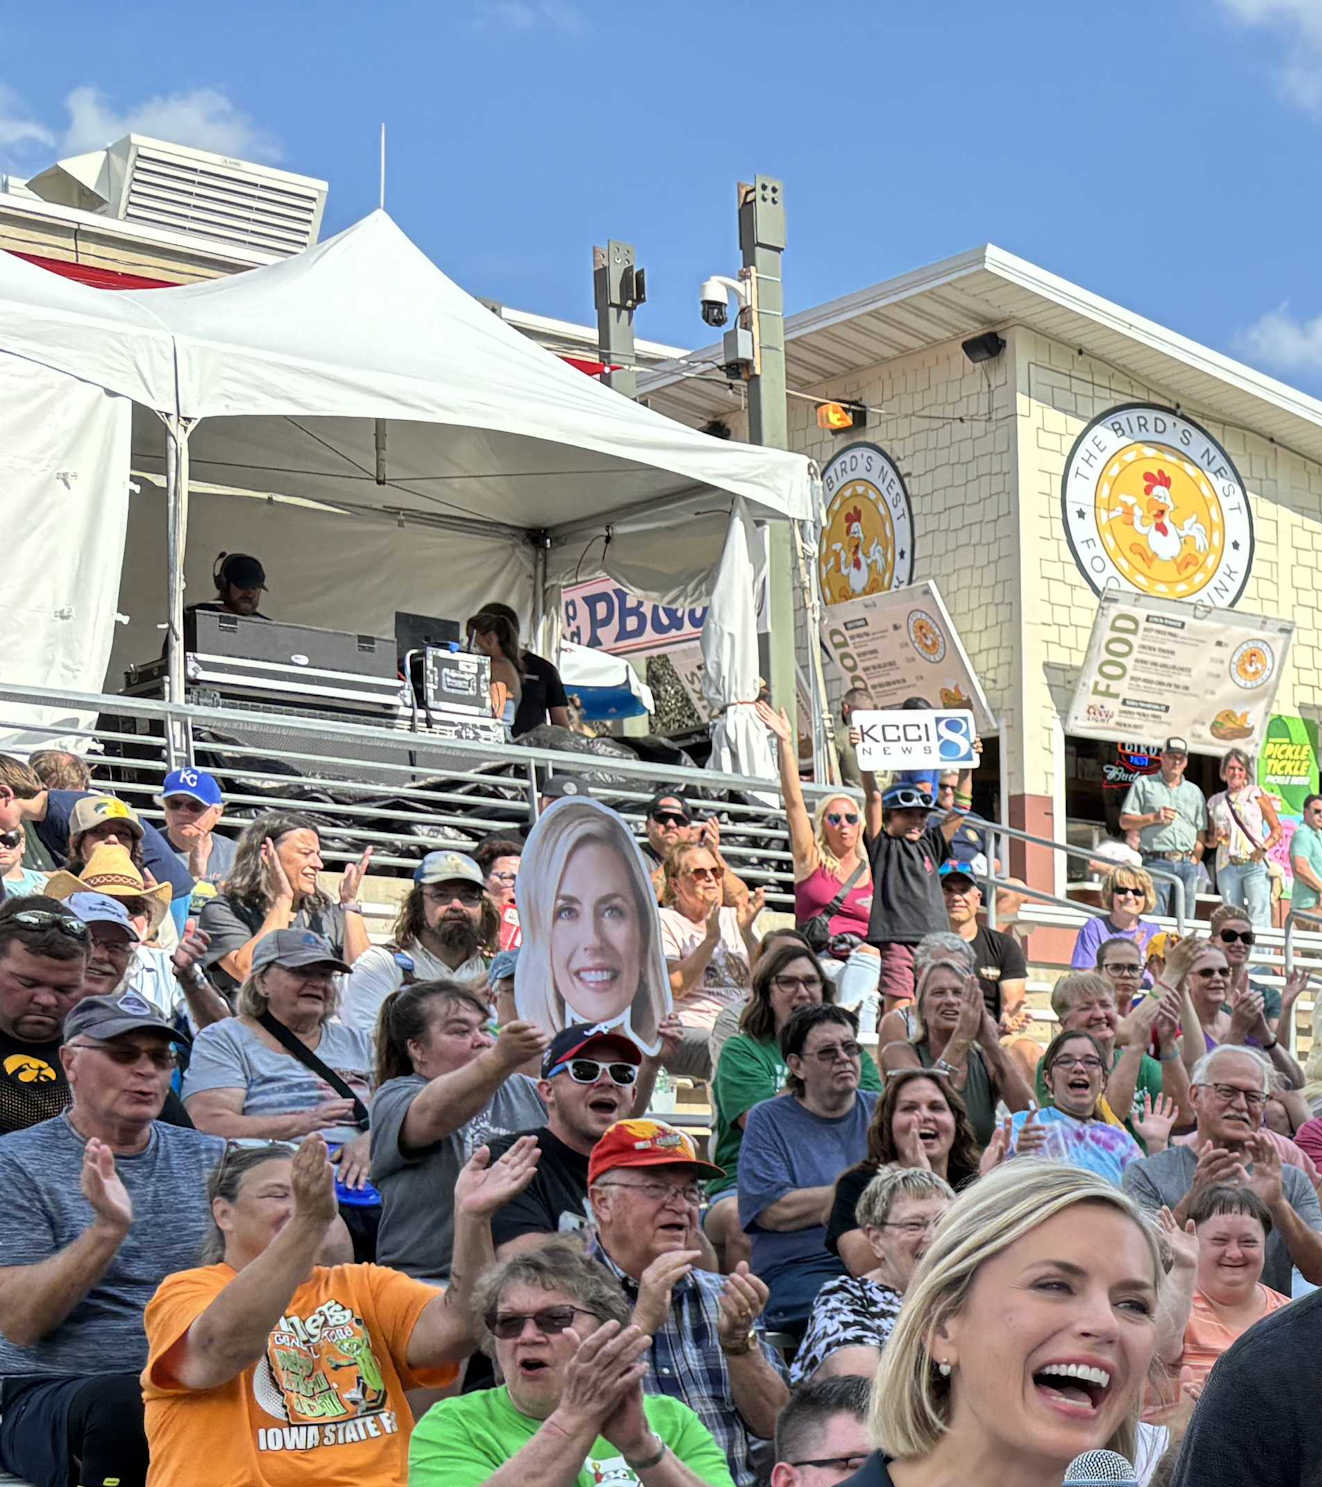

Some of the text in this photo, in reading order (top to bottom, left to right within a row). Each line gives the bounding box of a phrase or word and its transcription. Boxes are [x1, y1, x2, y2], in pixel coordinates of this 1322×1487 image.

[1074, 415, 1243, 516] THE BIRD'S NEST
[825, 452, 907, 522] BIRD'S NEST
[1080, 537, 1122, 589] FOO
[1091, 612, 1140, 700] FOOD
[859, 717, 971, 759] KCCI 8
[862, 747, 933, 756] NEWS
[1265, 743, 1311, 761] PICKLE
[179, 769, 198, 788] KC
[1267, 759, 1310, 776] TICKLE
[258, 1425, 320, 1451] IOWA
[323, 1415, 381, 1446] STATE
